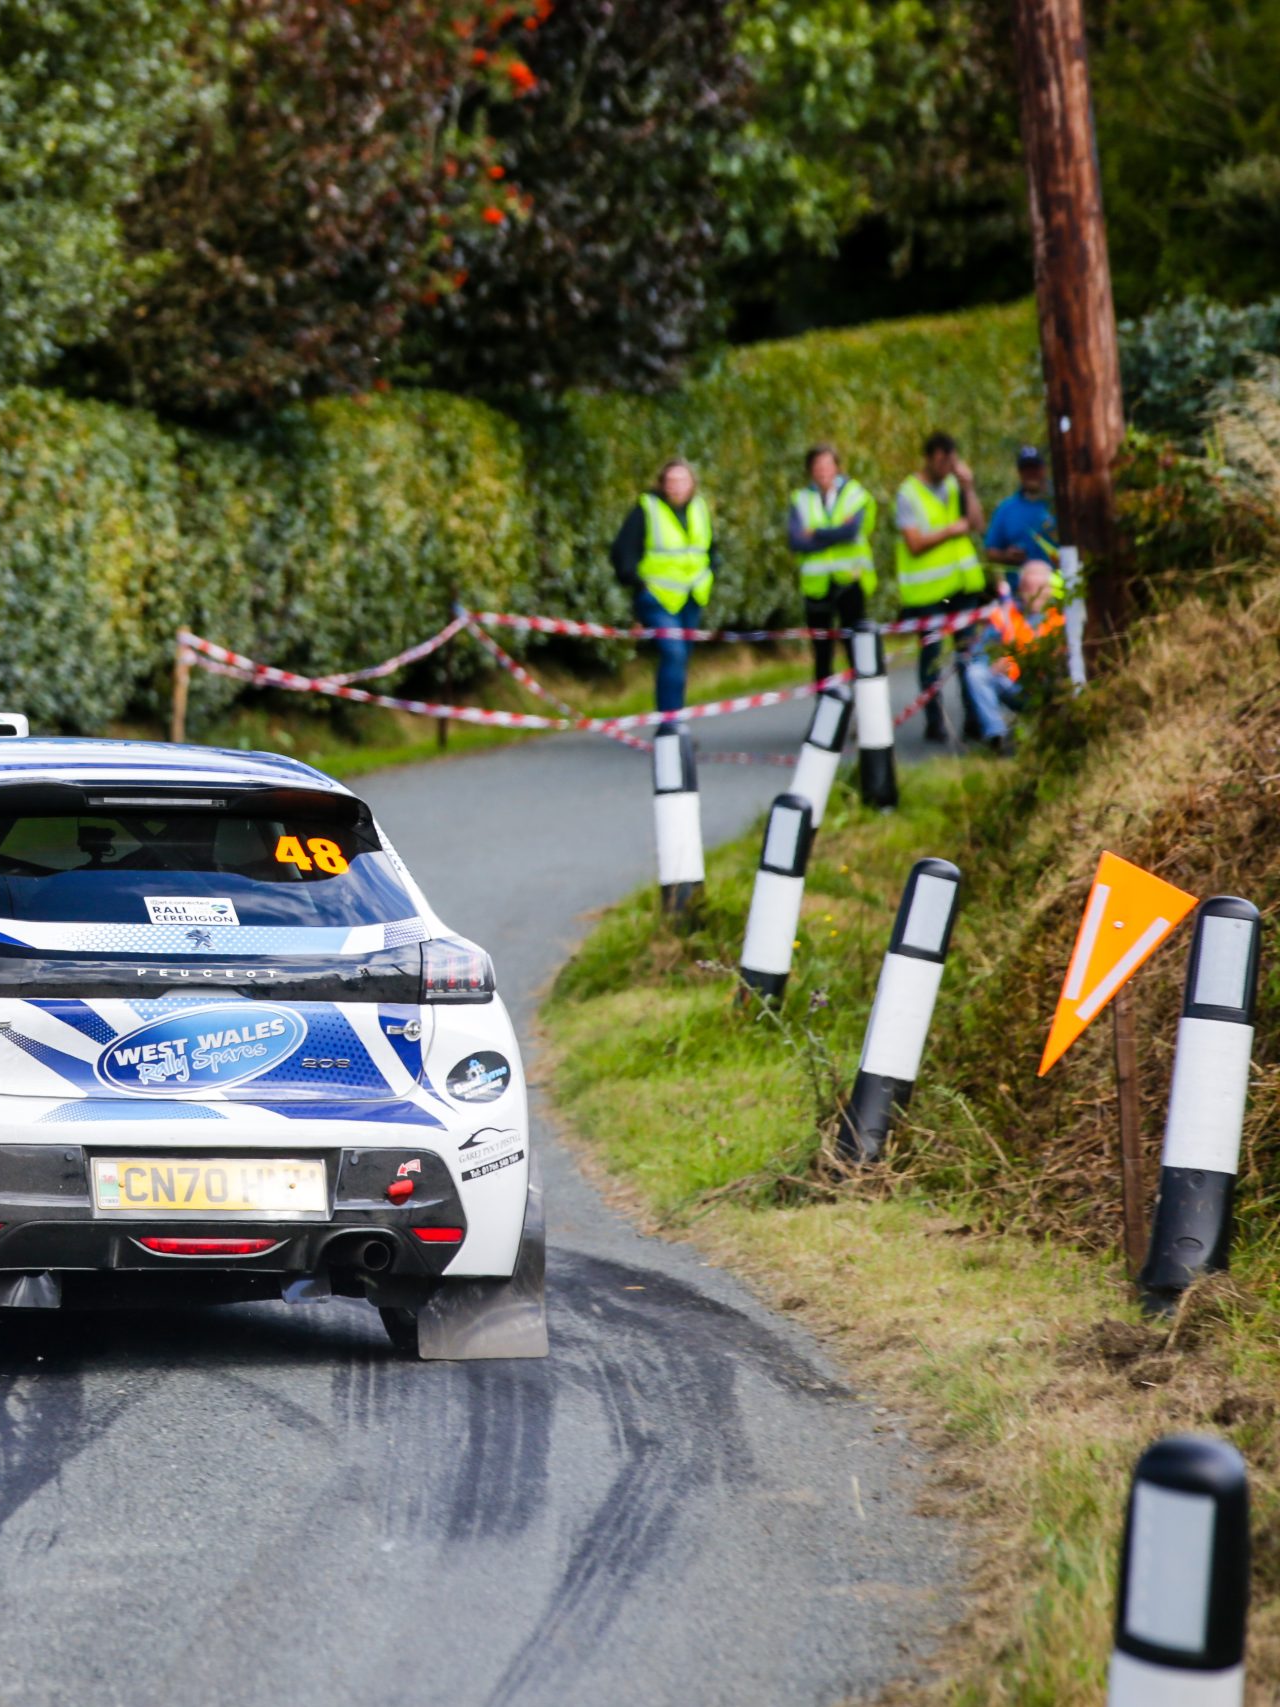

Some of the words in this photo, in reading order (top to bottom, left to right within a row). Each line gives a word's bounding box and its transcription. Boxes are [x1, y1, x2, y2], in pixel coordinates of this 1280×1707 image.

[275, 835, 351, 875] 48
[152, 906, 187, 914] RALI
[155, 914, 234, 923] CEREDIGION
[137, 968, 277, 978] PEUGEOT
[114, 1038, 188, 1066] WEST
[197, 1018, 286, 1050] WALES
[136, 1052, 190, 1084] Rally
[192, 1043, 268, 1073] Spares
[301, 1057, 351, 1069] 208
[124, 1167, 228, 1203] CN70
